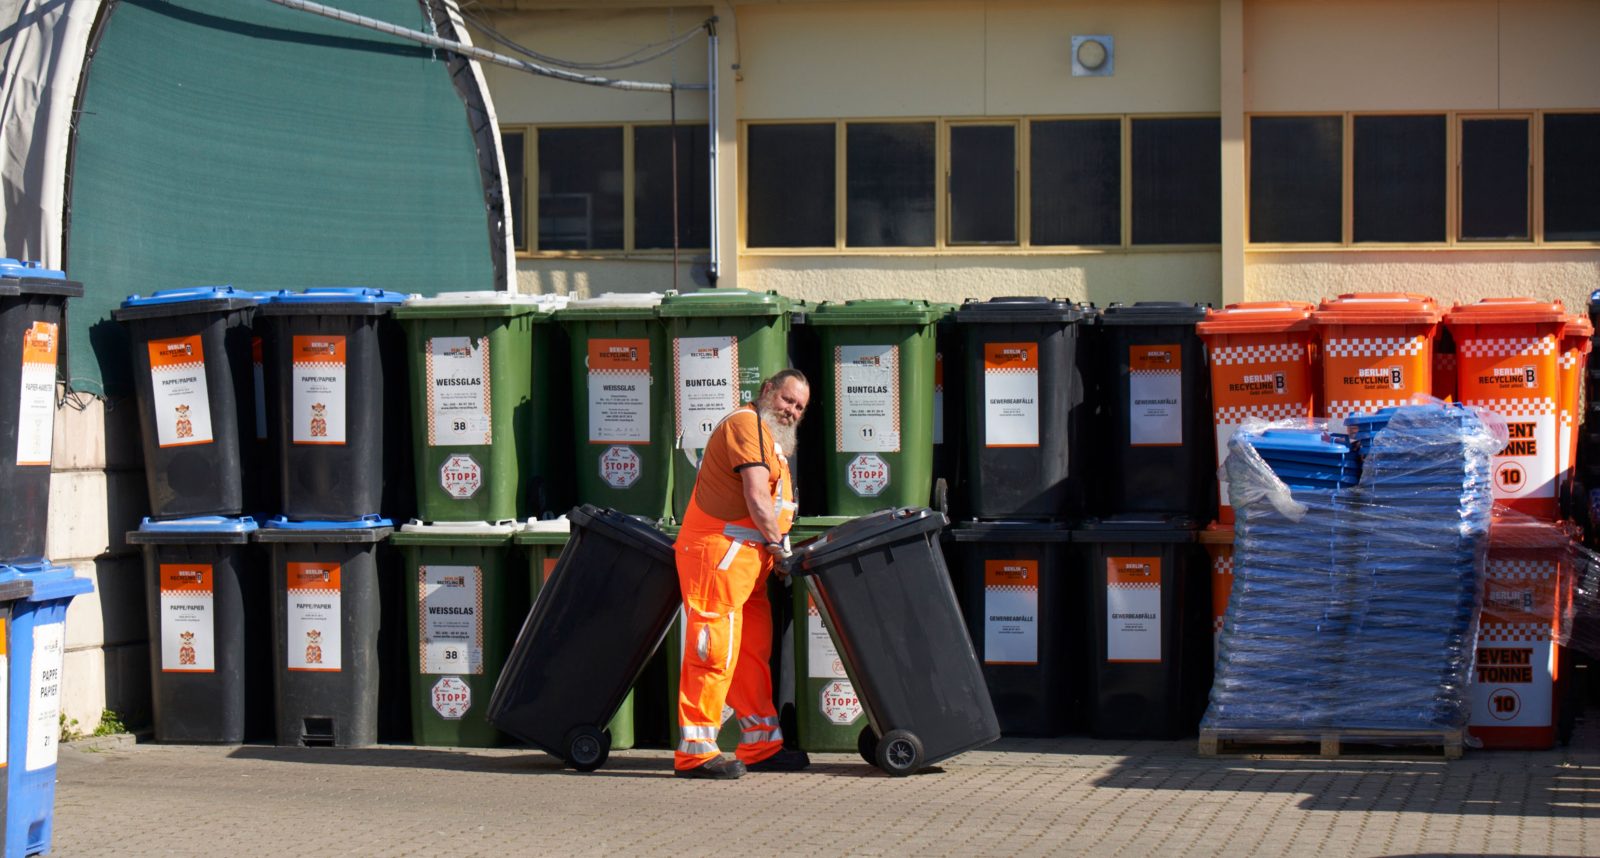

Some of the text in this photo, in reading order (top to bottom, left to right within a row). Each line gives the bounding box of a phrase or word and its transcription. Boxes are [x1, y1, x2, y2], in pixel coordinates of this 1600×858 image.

[1359, 368, 1389, 377] BERLIN
[1493, 367, 1523, 377] BERLIN
[436, 378, 481, 386] WEISSGLAS
[685, 379, 727, 387] BUNTGLAS
[1243, 374, 1273, 383] BERLIN
[1343, 376, 1390, 385] RECYCLING
[1478, 375, 1524, 384] RECYCLING
[603, 384, 635, 392] WEISSGLAS
[847, 386, 888, 394] BUNTGLAS
[1229, 382, 1274, 392] RECYCLING
[453, 422, 466, 431] 38
[702, 423, 712, 432] 11
[1507, 423, 1536, 438] ENT
[862, 428, 873, 437] 11
[605, 462, 636, 471] STOPP
[445, 472, 477, 481] STOPP
[852, 470, 884, 479] STOPP
[1501, 470, 1520, 485] 10
[429, 606, 473, 615] WEISSGLAS
[446, 651, 457, 660] 38
[1477, 649, 1533, 664] EVENT
[42, 668, 58, 682] PAPPE
[1477, 666, 1532, 682] TONNE
[40, 684, 58, 698] PAPIER
[436, 693, 467, 702] STOPP
[826, 697, 858, 706] STOPP
[1494, 695, 1515, 712] 10
